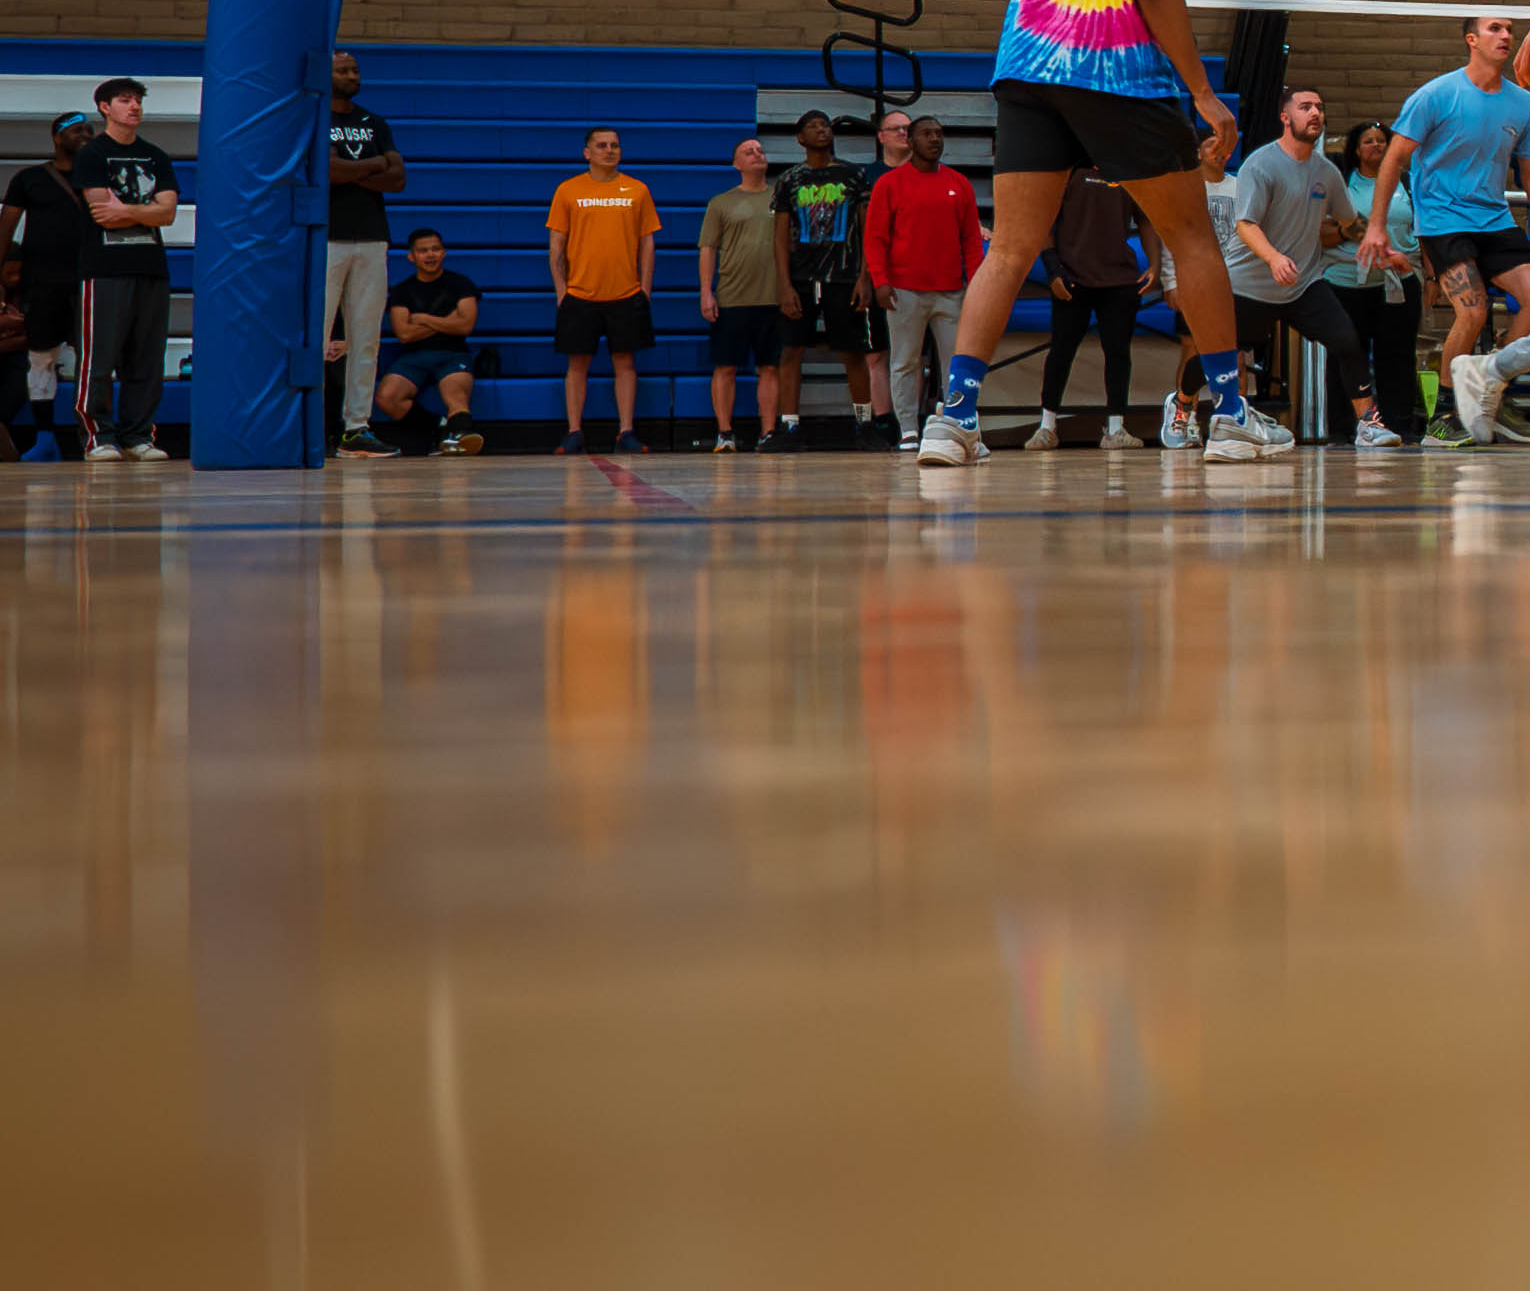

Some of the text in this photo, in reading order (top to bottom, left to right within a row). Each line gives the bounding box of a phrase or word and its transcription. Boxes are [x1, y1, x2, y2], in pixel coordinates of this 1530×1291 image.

[344, 126, 374, 141] USAF
[797, 181, 848, 206] AC/DC
[576, 197, 633, 208] TENNESSEE
